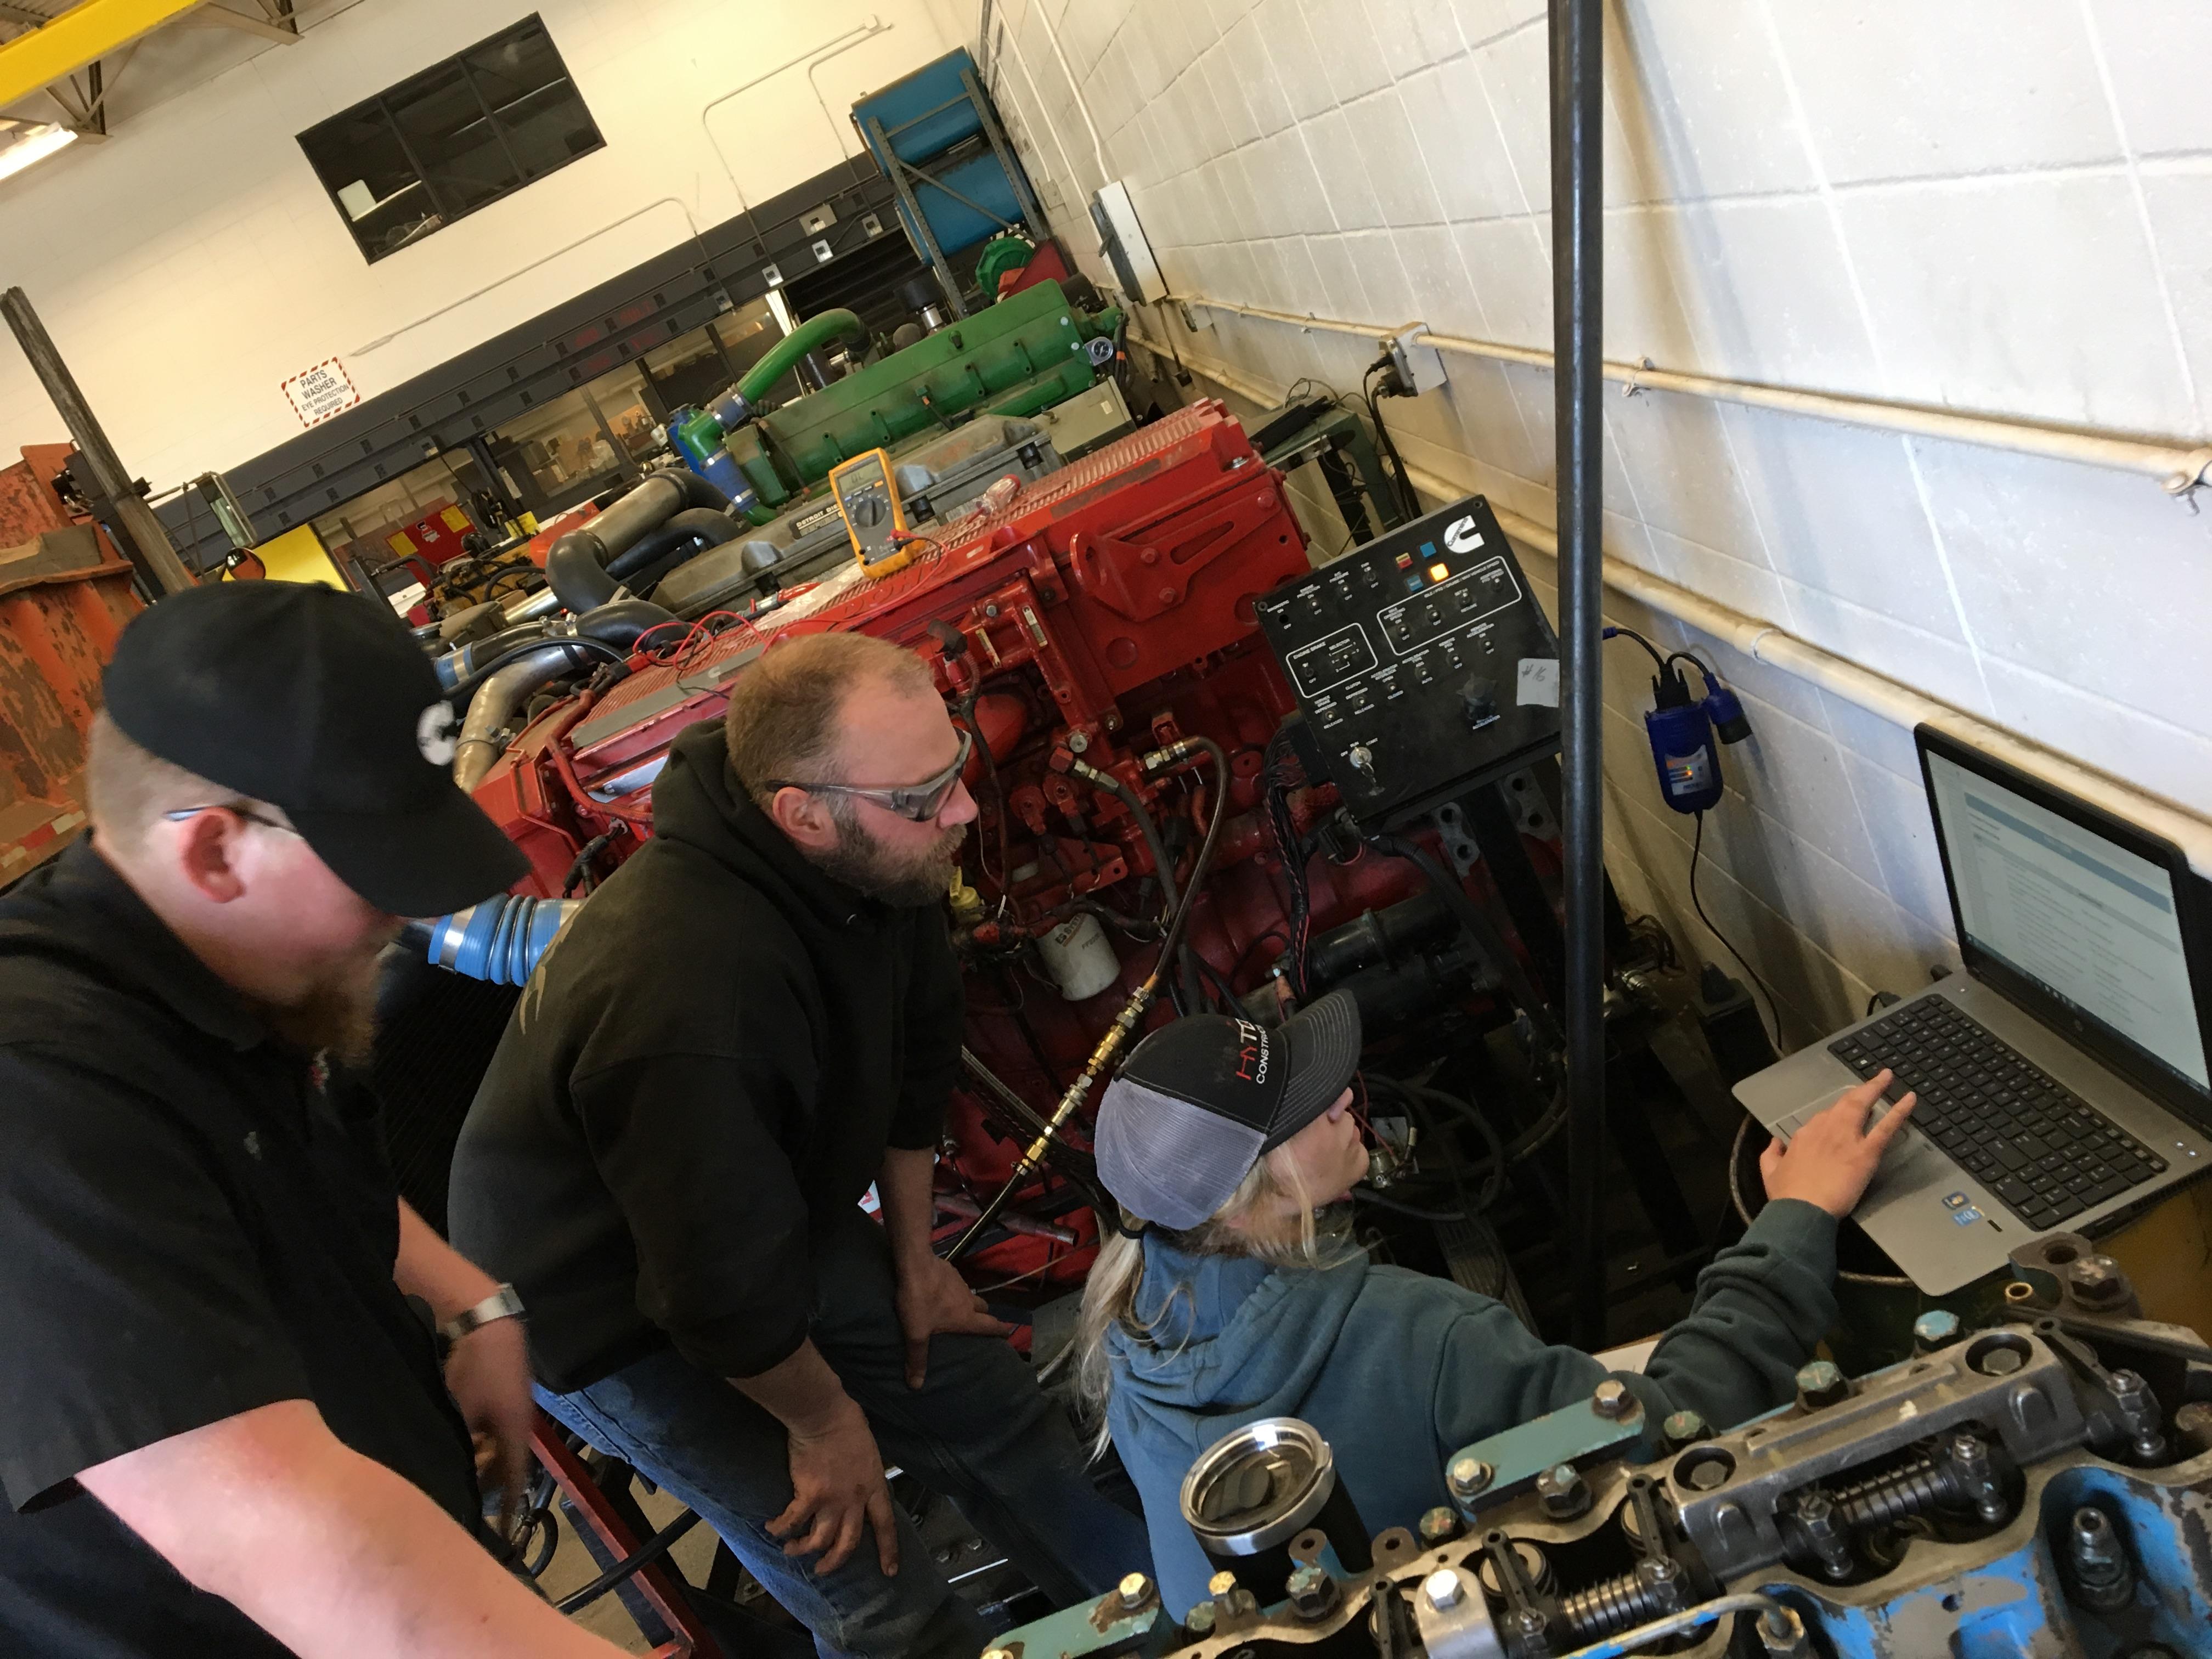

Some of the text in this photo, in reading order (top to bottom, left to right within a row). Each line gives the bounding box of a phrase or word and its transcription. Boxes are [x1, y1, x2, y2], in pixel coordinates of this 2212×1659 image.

[300, 370, 327, 388] PARTS
[302, 377, 337, 399] WASHER
[301, 384, 349, 411] EYE PROTECTION
[314, 397, 343, 415] REQUIRED
[796, 511, 823, 527] DETROIT
[1447, 517, 1468, 546] Cummins
[1293, 642, 1326, 659] ENGINE BRAKE
[1329, 638, 1350, 650] SELECTOR
